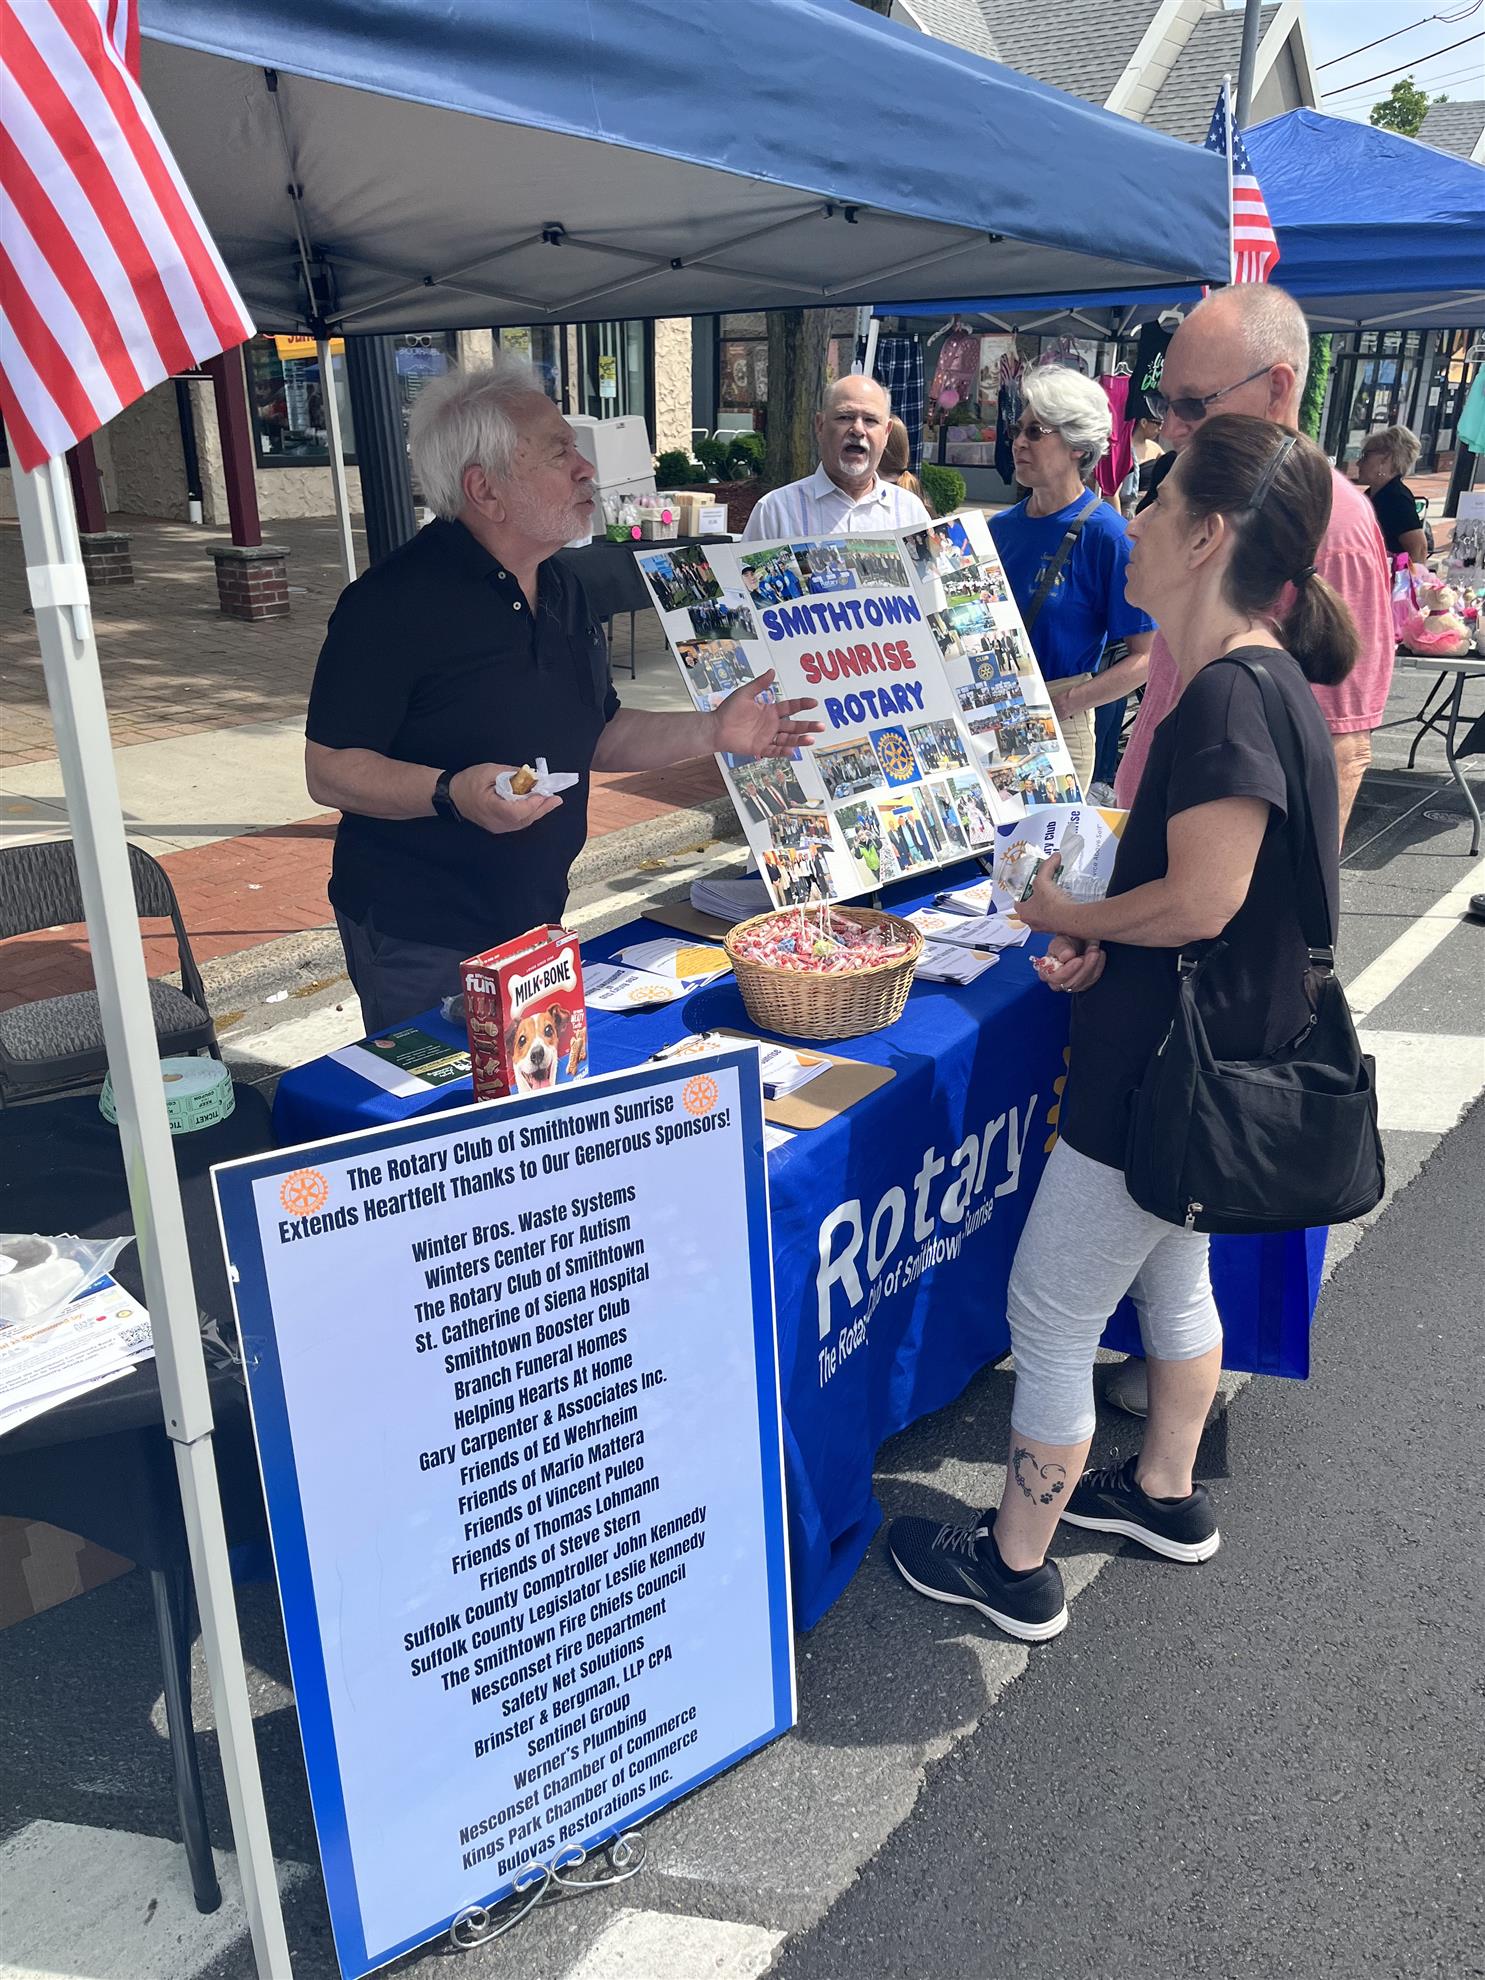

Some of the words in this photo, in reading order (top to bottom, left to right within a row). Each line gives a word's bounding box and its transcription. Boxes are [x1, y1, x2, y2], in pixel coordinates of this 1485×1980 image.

[762, 595, 922, 641] SMITHTOWN
[800, 640, 917, 684] SUNRISE
[824, 681, 923, 729] ROTARY
[1044, 821, 1057, 841] Club
[465, 973, 497, 995] fun
[515, 975, 541, 1007] MILK
[543, 960, 571, 988] BONE
[170, 1121, 182, 1129] TIC
[195, 1111, 219, 1124] TICKET
[345, 1165, 383, 1191] The
[385, 1148, 448, 1182] Rotary
[452, 1135, 493, 1165] Club
[496, 1129, 515, 1154] of
[518, 1109, 610, 1148] Smithtown
[612, 1094, 674, 1125] Sunrise
[277, 1205, 359, 1244] Extends
[362, 1179, 447, 1222] Heartfelt
[448, 1165, 516, 1199] Thanks
[518, 1159, 538, 1181] to
[540, 1150, 570, 1175] Our
[573, 1130, 652, 1166] Generous
[654, 1106, 731, 1146] Sponsors!
[815, 1093, 1038, 1341] Rotary
[410, 1230, 468, 1263] Winter
[471, 1219, 515, 1246] Bros.
[517, 1203, 568, 1233] Waste
[570, 1184, 636, 1218] Systems
[423, 1255, 491, 1290] Winters
[493, 1238, 546, 1270] Center
[549, 1229, 575, 1253] For
[578, 1213, 631, 1245] Autism
[413, 1299, 446, 1323] The
[448, 1280, 502, 1313] Rotary
[505, 1267, 542, 1295] Club
[544, 1260, 561, 1283] of
[563, 1237, 645, 1277] Smithtown
[414, 1330, 438, 1354] St.
[440, 1305, 521, 1345] Catherine
[523, 1295, 540, 1319] of
[542, 1284, 587, 1313] Siena
[588, 1261, 650, 1298] Hospital
[818, 1346, 836, 1388] The
[838, 1316, 869, 1365] Rotar
[884, 1260, 903, 1297] of
[902, 1235, 962, 1288] Smithtown
[443, 1330, 532, 1374] Smithtown
[534, 1309, 595, 1345] Booster
[597, 1296, 630, 1323] Club
[453, 1365, 512, 1401] Branch
[514, 1342, 574, 1380] Funeral
[575, 1326, 628, 1359] Homes
[418, 1443, 456, 1472] Gary
[459, 1413, 539, 1456] Carpenter
[542, 1408, 554, 1427] &
[556, 1377, 638, 1422] Associates
[640, 1368, 668, 1390] Inc.
[453, 1393, 515, 1431] Helping
[517, 1375, 569, 1408] Hearts
[572, 1365, 589, 1388] At
[590, 1352, 633, 1381] Home
[457, 1478, 518, 1516] Friends
[520, 1467, 537, 1491] of
[539, 1452, 585, 1484] Mario
[586, 1428, 645, 1465] Mattera
[458, 1449, 520, 1486] Friends
[522, 1438, 539, 1462] of
[541, 1430, 561, 1455] Ed
[562, 1404, 638, 1446] Wehrheim
[450, 1536, 512, 1575] Friends
[514, 1525, 530, 1548] of
[532, 1503, 592, 1540] Thomas
[594, 1474, 660, 1515] Lohmann
[463, 1504, 524, 1542] Friends
[525, 1493, 542, 1516] of
[544, 1469, 602, 1508] Vincent
[603, 1455, 644, 1485] Puleo
[402, 1612, 462, 1652] Suffolk
[464, 1587, 519, 1625] County
[521, 1548, 609, 1600] Comptroller
[612, 1531, 648, 1560] John
[649, 1504, 707, 1544] Kennedy
[478, 1553, 538, 1592] Friends
[540, 1542, 556, 1565] of
[558, 1526, 601, 1557] Steve
[602, 1508, 641, 1538] Stern
[409, 1638, 469, 1677] Suffolk
[470, 1612, 525, 1650] County
[527, 1577, 602, 1625] Legislator
[604, 1558, 646, 1590] Leslie
[648, 1529, 705, 1569] Kennedy
[439, 1665, 470, 1691] The
[472, 1625, 556, 1676] Smithtown
[558, 1611, 587, 1637] Fire
[589, 1589, 634, 1622] Chiefs
[635, 1561, 686, 1600] Council
[470, 1651, 553, 1706] Nesconset
[554, 1639, 583, 1665] Fire
[585, 1596, 667, 1651] Department
[500, 1681, 548, 1717] Safety
[551, 1666, 577, 1693] Net
[578, 1634, 645, 1679] Solutions
[473, 1714, 535, 1759] Brinster
[538, 1708, 549, 1726] &
[551, 1674, 620, 1719] Bergman,
[622, 1657, 645, 1683] LLP
[647, 1643, 673, 1669] CPA
[526, 1712, 587, 1757] Sentinel
[589, 1691, 630, 1725] Group
[458, 1788, 540, 1846] Nesconset
[542, 1754, 606, 1801] Chamber
[608, 1742, 623, 1764] of
[625, 1705, 697, 1755] Commerce
[512, 1744, 580, 1790] Werner's
[581, 1707, 647, 1754] Plumbing
[461, 1836, 505, 1871] Kings
[507, 1814, 542, 1846] Park
[544, 1778, 608, 1825] Chamber
[610, 1766, 625, 1788] of
[627, 1727, 698, 1778] Commerce
[496, 1833, 556, 1877] Bulovas
[558, 1781, 646, 1843] Restorations
[648, 1768, 673, 1792] Inc.
